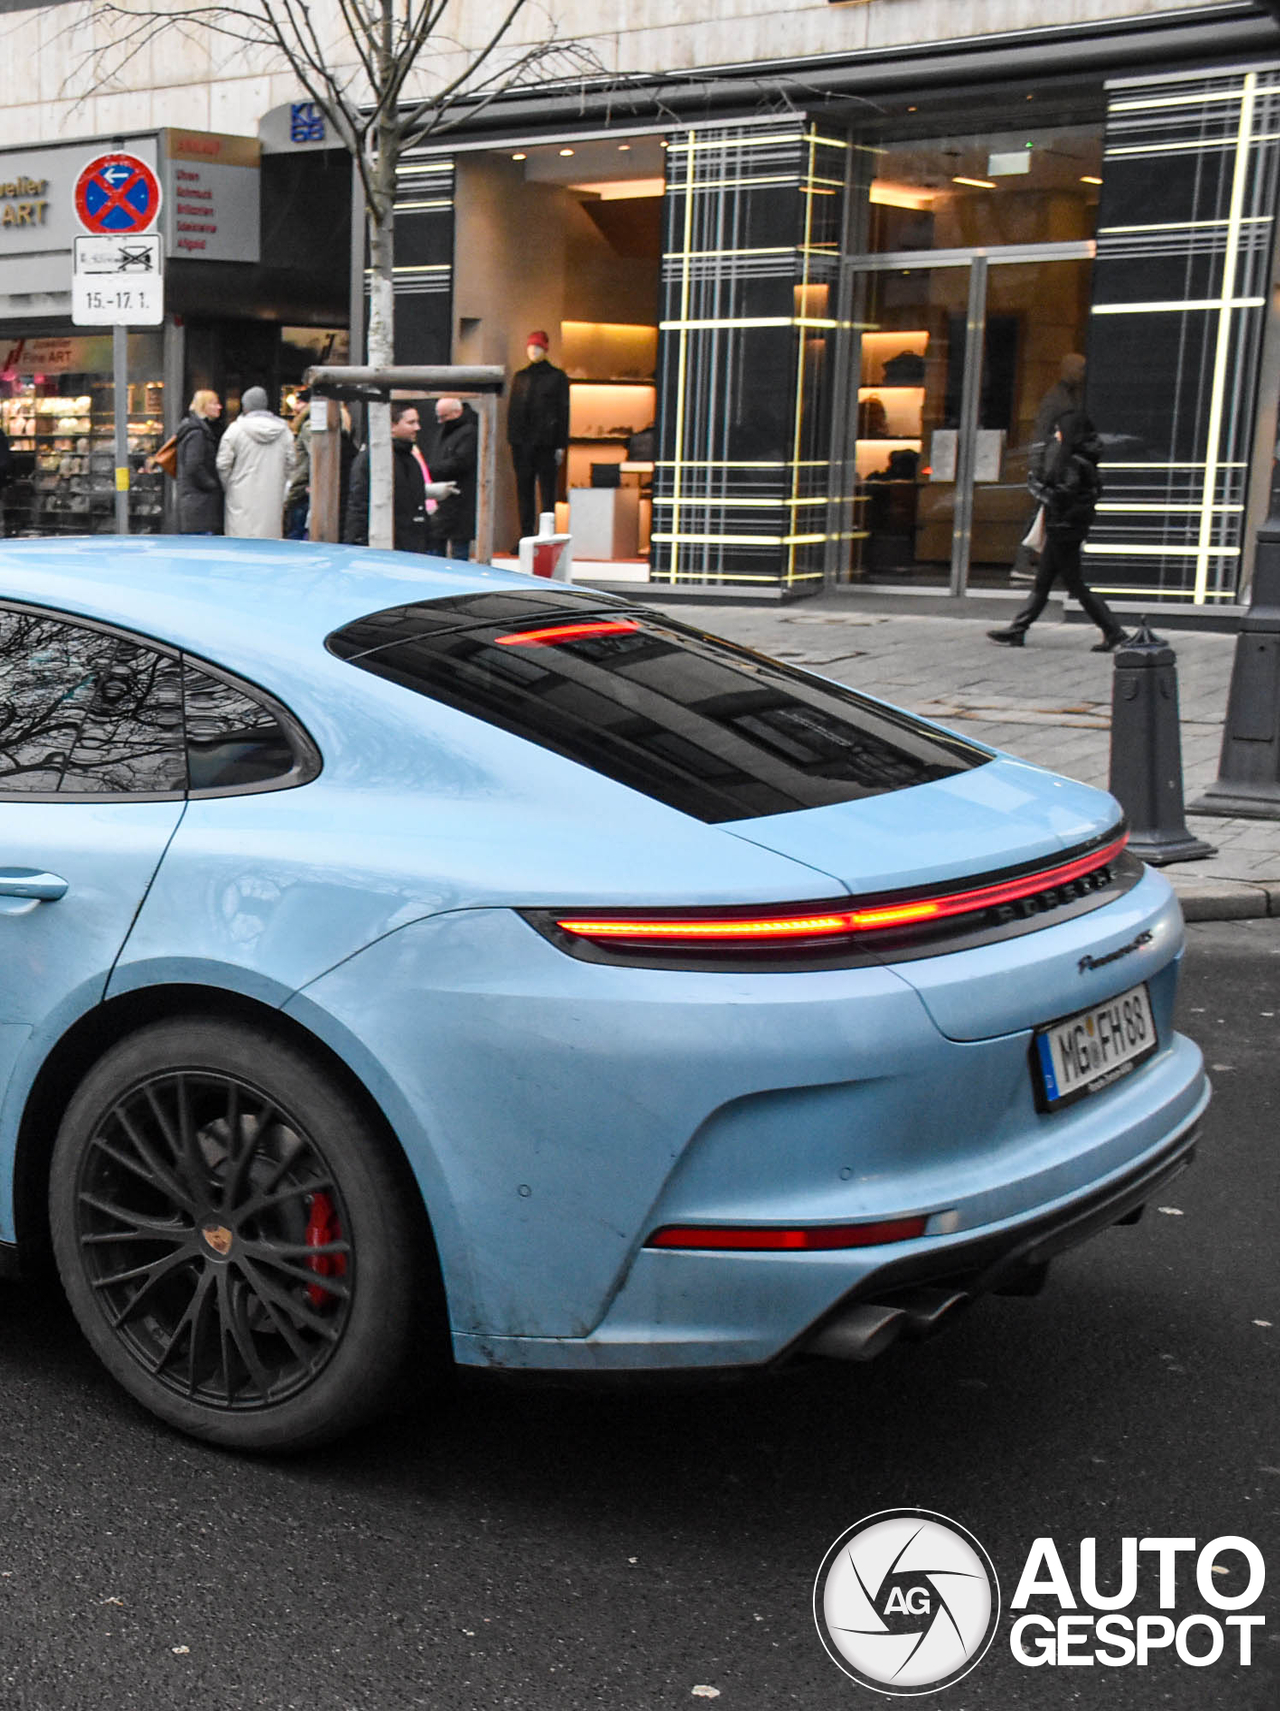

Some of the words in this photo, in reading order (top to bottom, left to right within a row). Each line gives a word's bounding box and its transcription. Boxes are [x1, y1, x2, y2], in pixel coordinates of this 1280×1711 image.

[2, 200, 48, 228] ART
[48, 351, 72, 363] ART
[1058, 1024, 1091, 1083] MG
